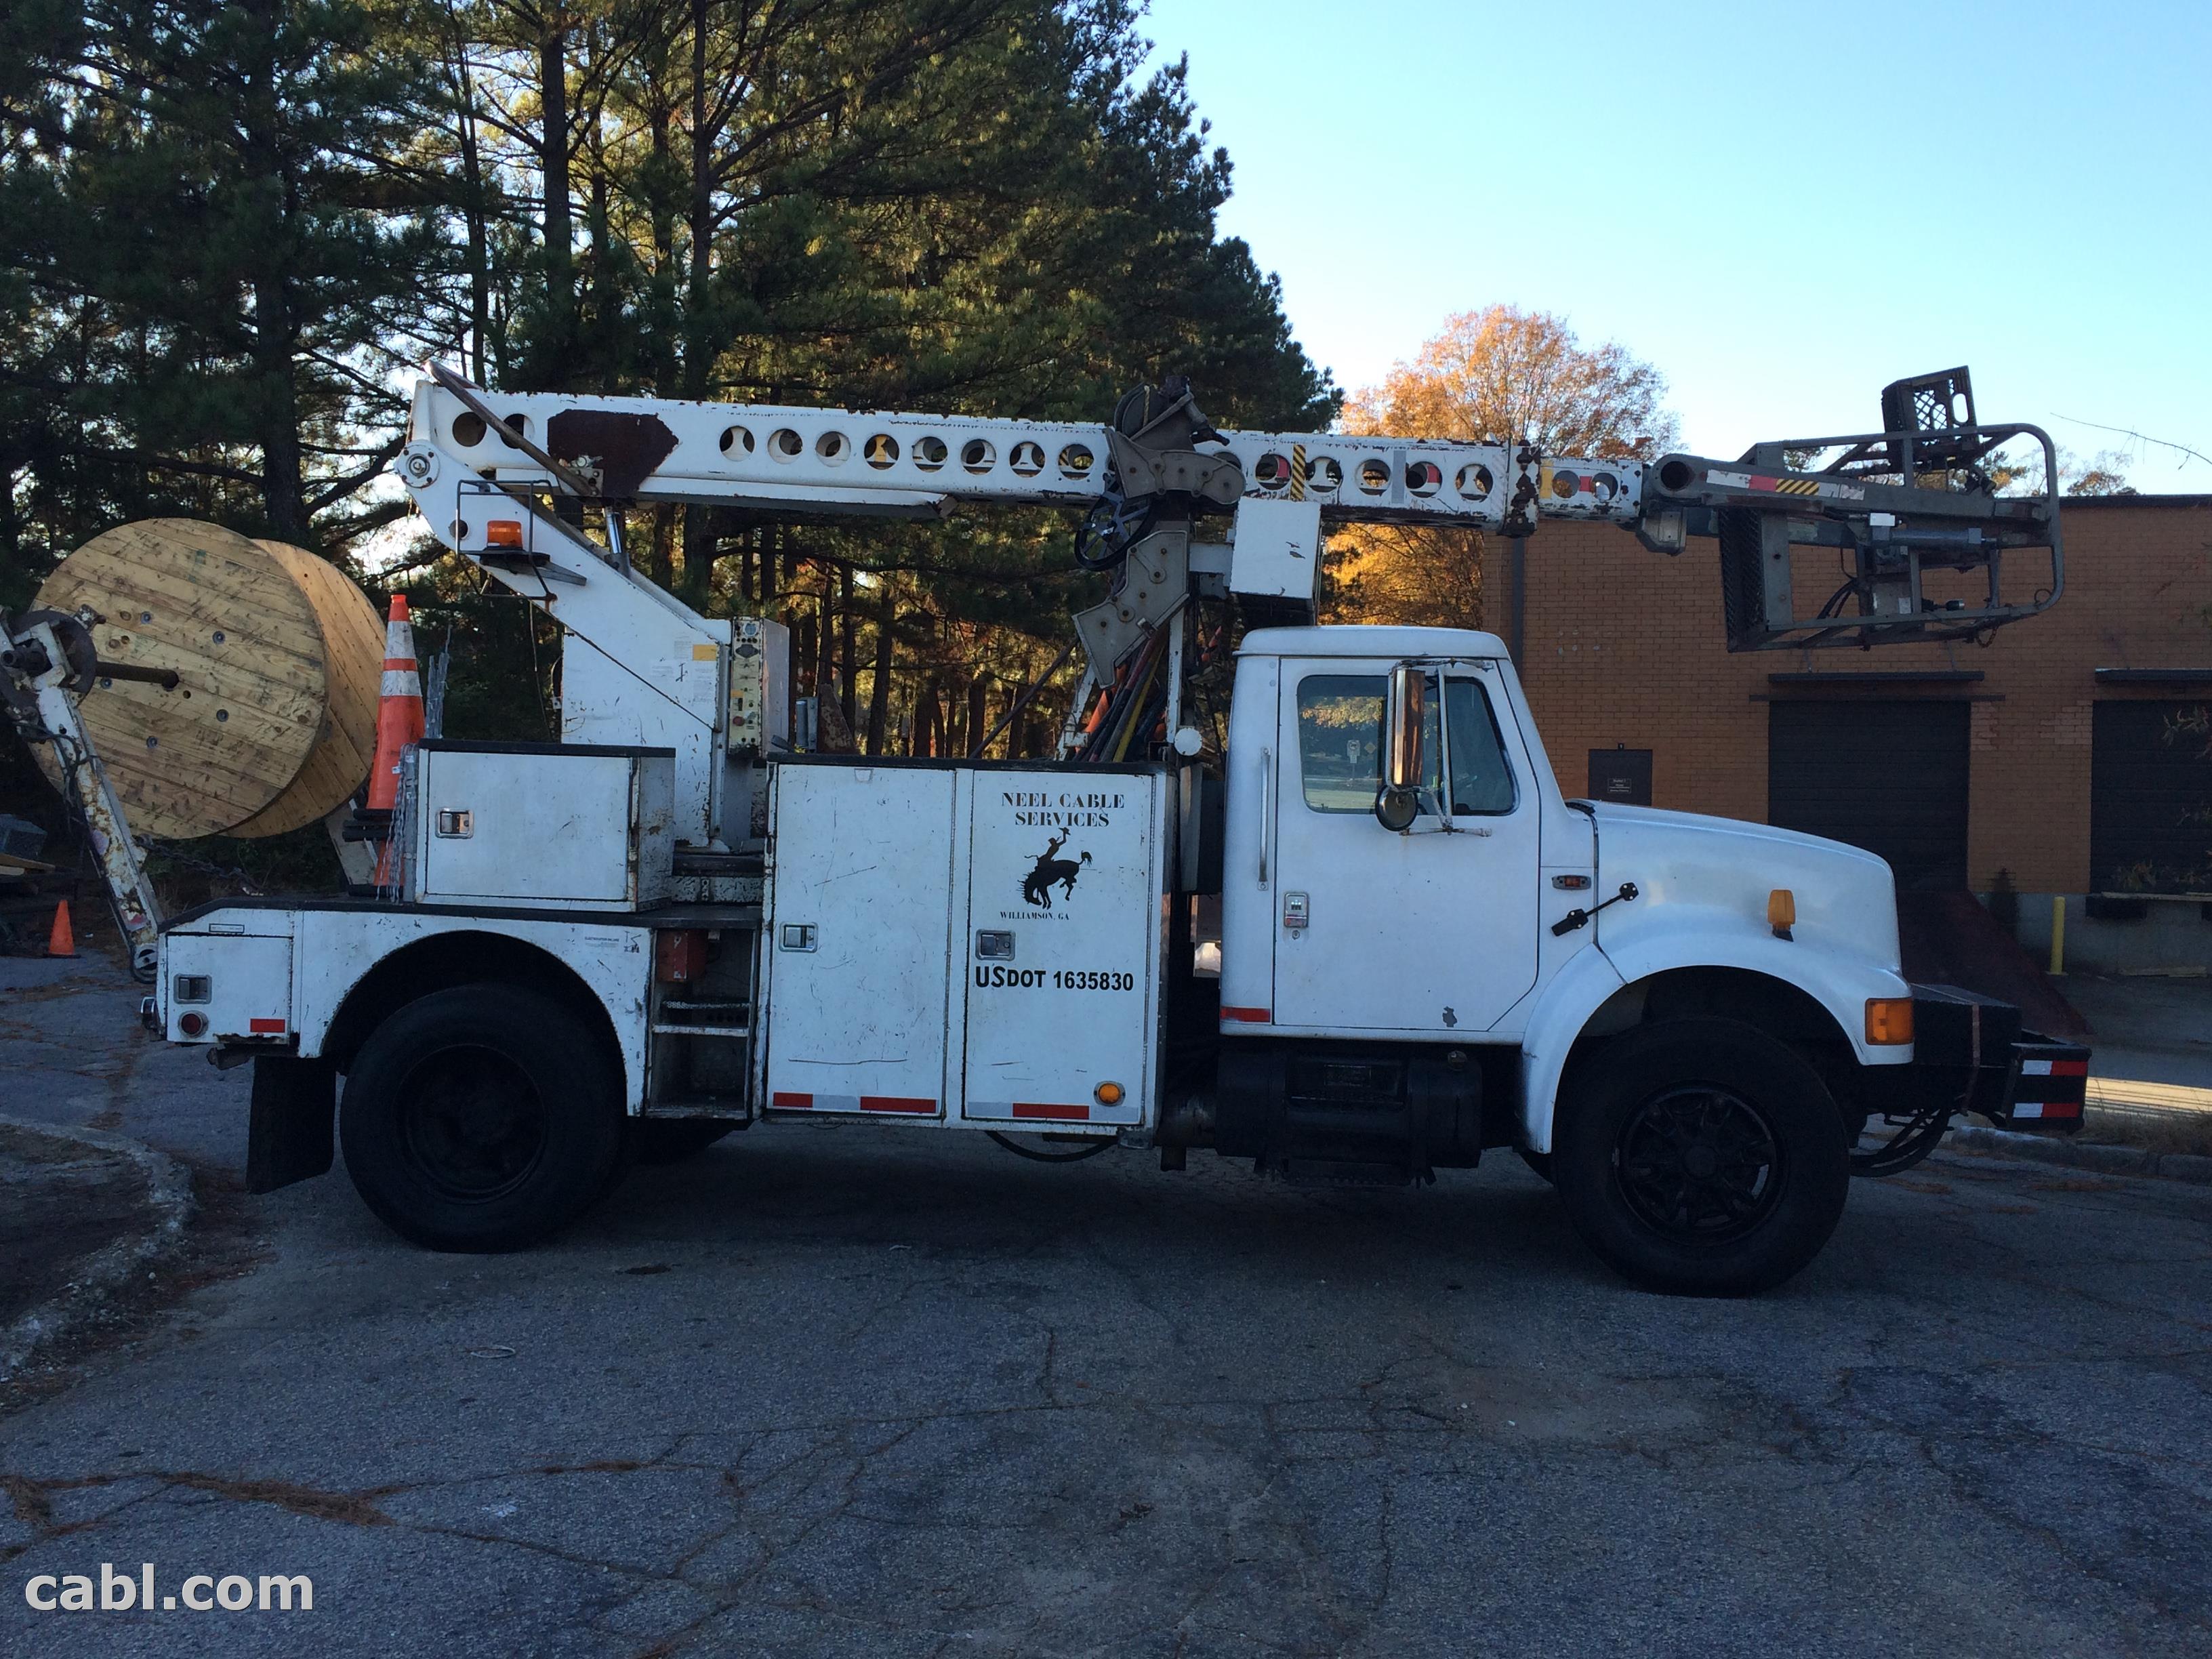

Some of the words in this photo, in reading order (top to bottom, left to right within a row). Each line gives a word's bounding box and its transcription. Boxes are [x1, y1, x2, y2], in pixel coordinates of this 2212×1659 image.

[1002, 792, 1052, 808] NEEL
[1059, 793, 1125, 809] CABLE
[1015, 811, 1110, 827] SERVICES
[1000, 910, 1056, 921] WILLIAMSON,
[1057, 912, 1070, 921] GA
[975, 965, 1046, 988] USDOT
[1053, 970, 1134, 991] 1635830
